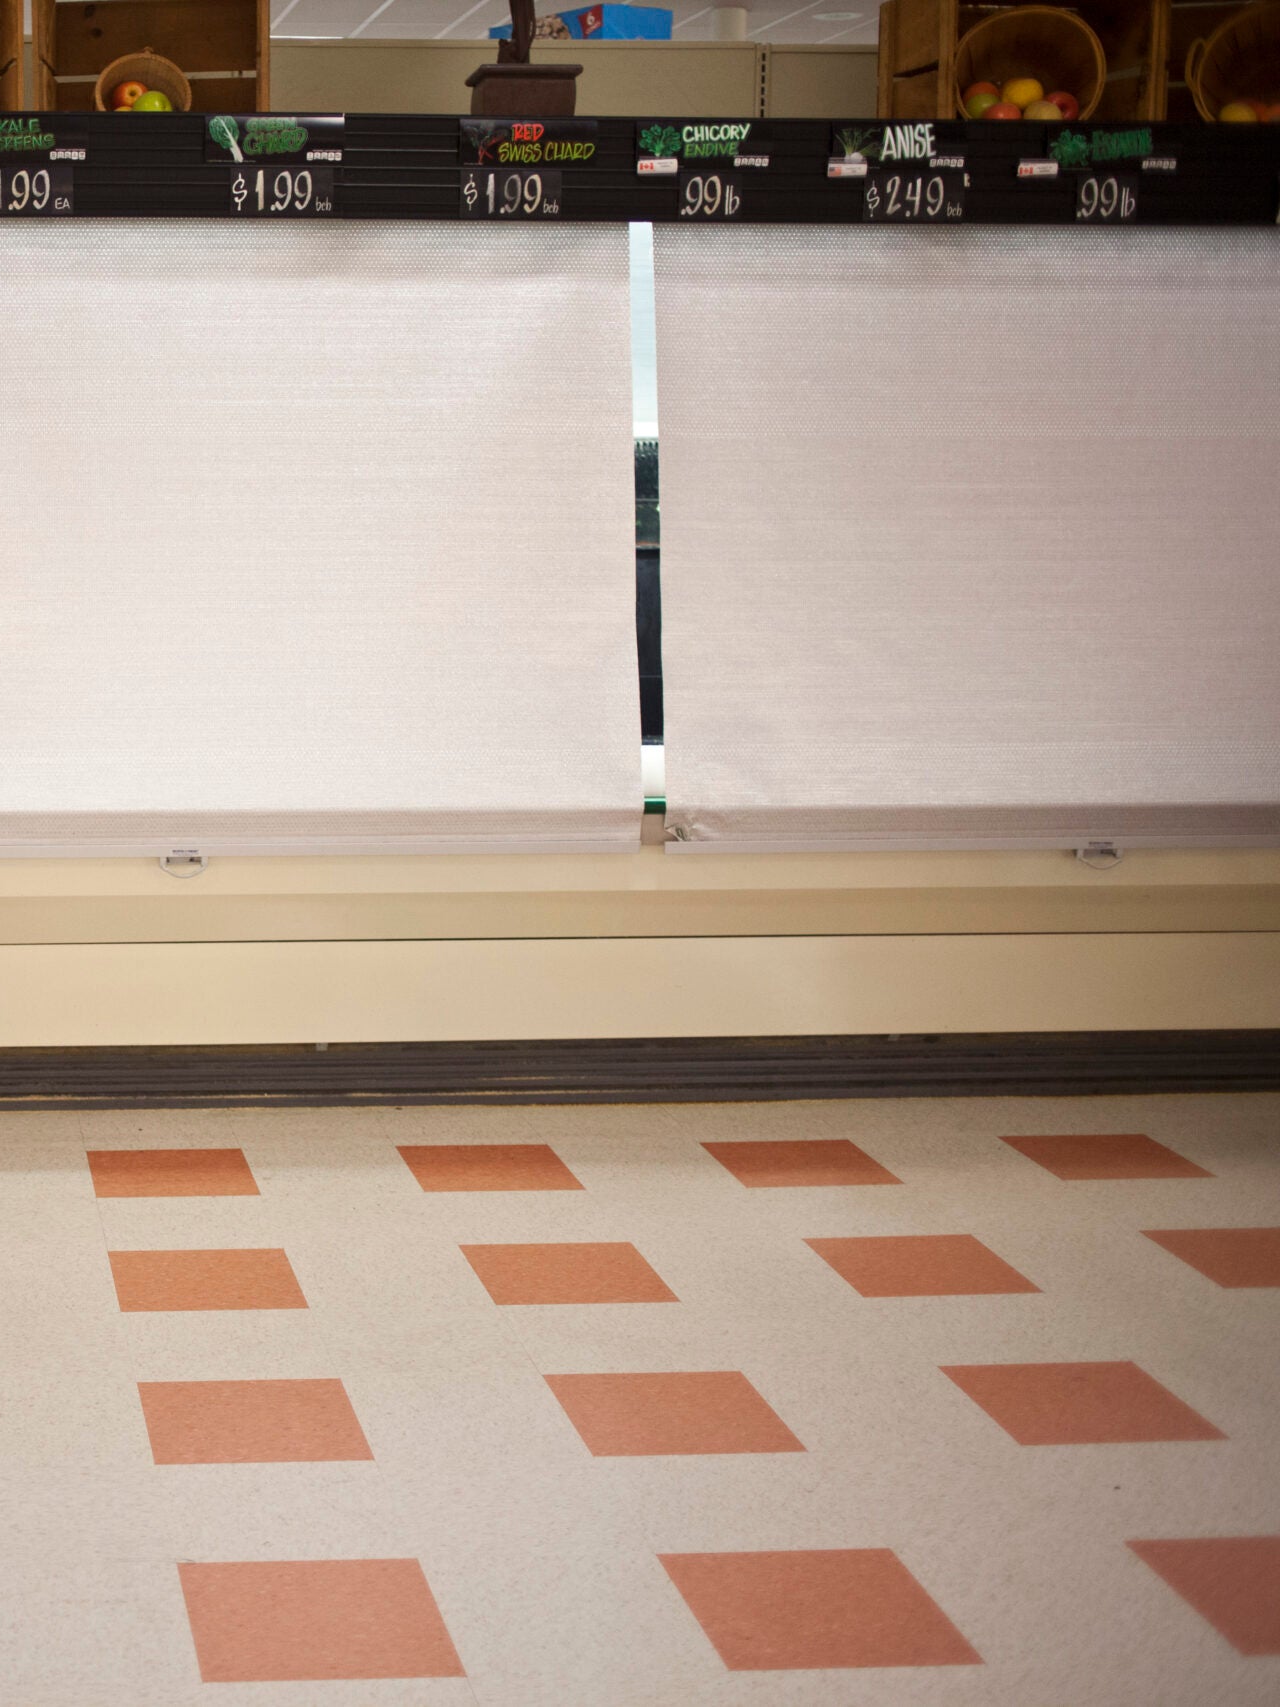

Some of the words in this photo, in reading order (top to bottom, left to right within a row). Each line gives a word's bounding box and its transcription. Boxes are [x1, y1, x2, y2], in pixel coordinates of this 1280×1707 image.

[511, 123, 545, 142] RED
[682, 122, 751, 143] CHICORY
[879, 123, 937, 162] ANISE
[498, 141, 542, 163] SWISS
[544, 142, 596, 161] CHARD
[683, 141, 740, 158] ENDIVE
[232, 169, 313, 212] $1.99
[315, 196, 332, 212] bch
[463, 172, 542, 215] $1.99
[542, 198, 559, 214] bch
[680, 175, 722, 216] .99
[724, 184, 741, 216] lb
[1076, 177, 1119, 219] .99
[1120, 186, 1136, 218] lb
[54, 197, 71, 210] EA
[946, 201, 963, 217] bch
